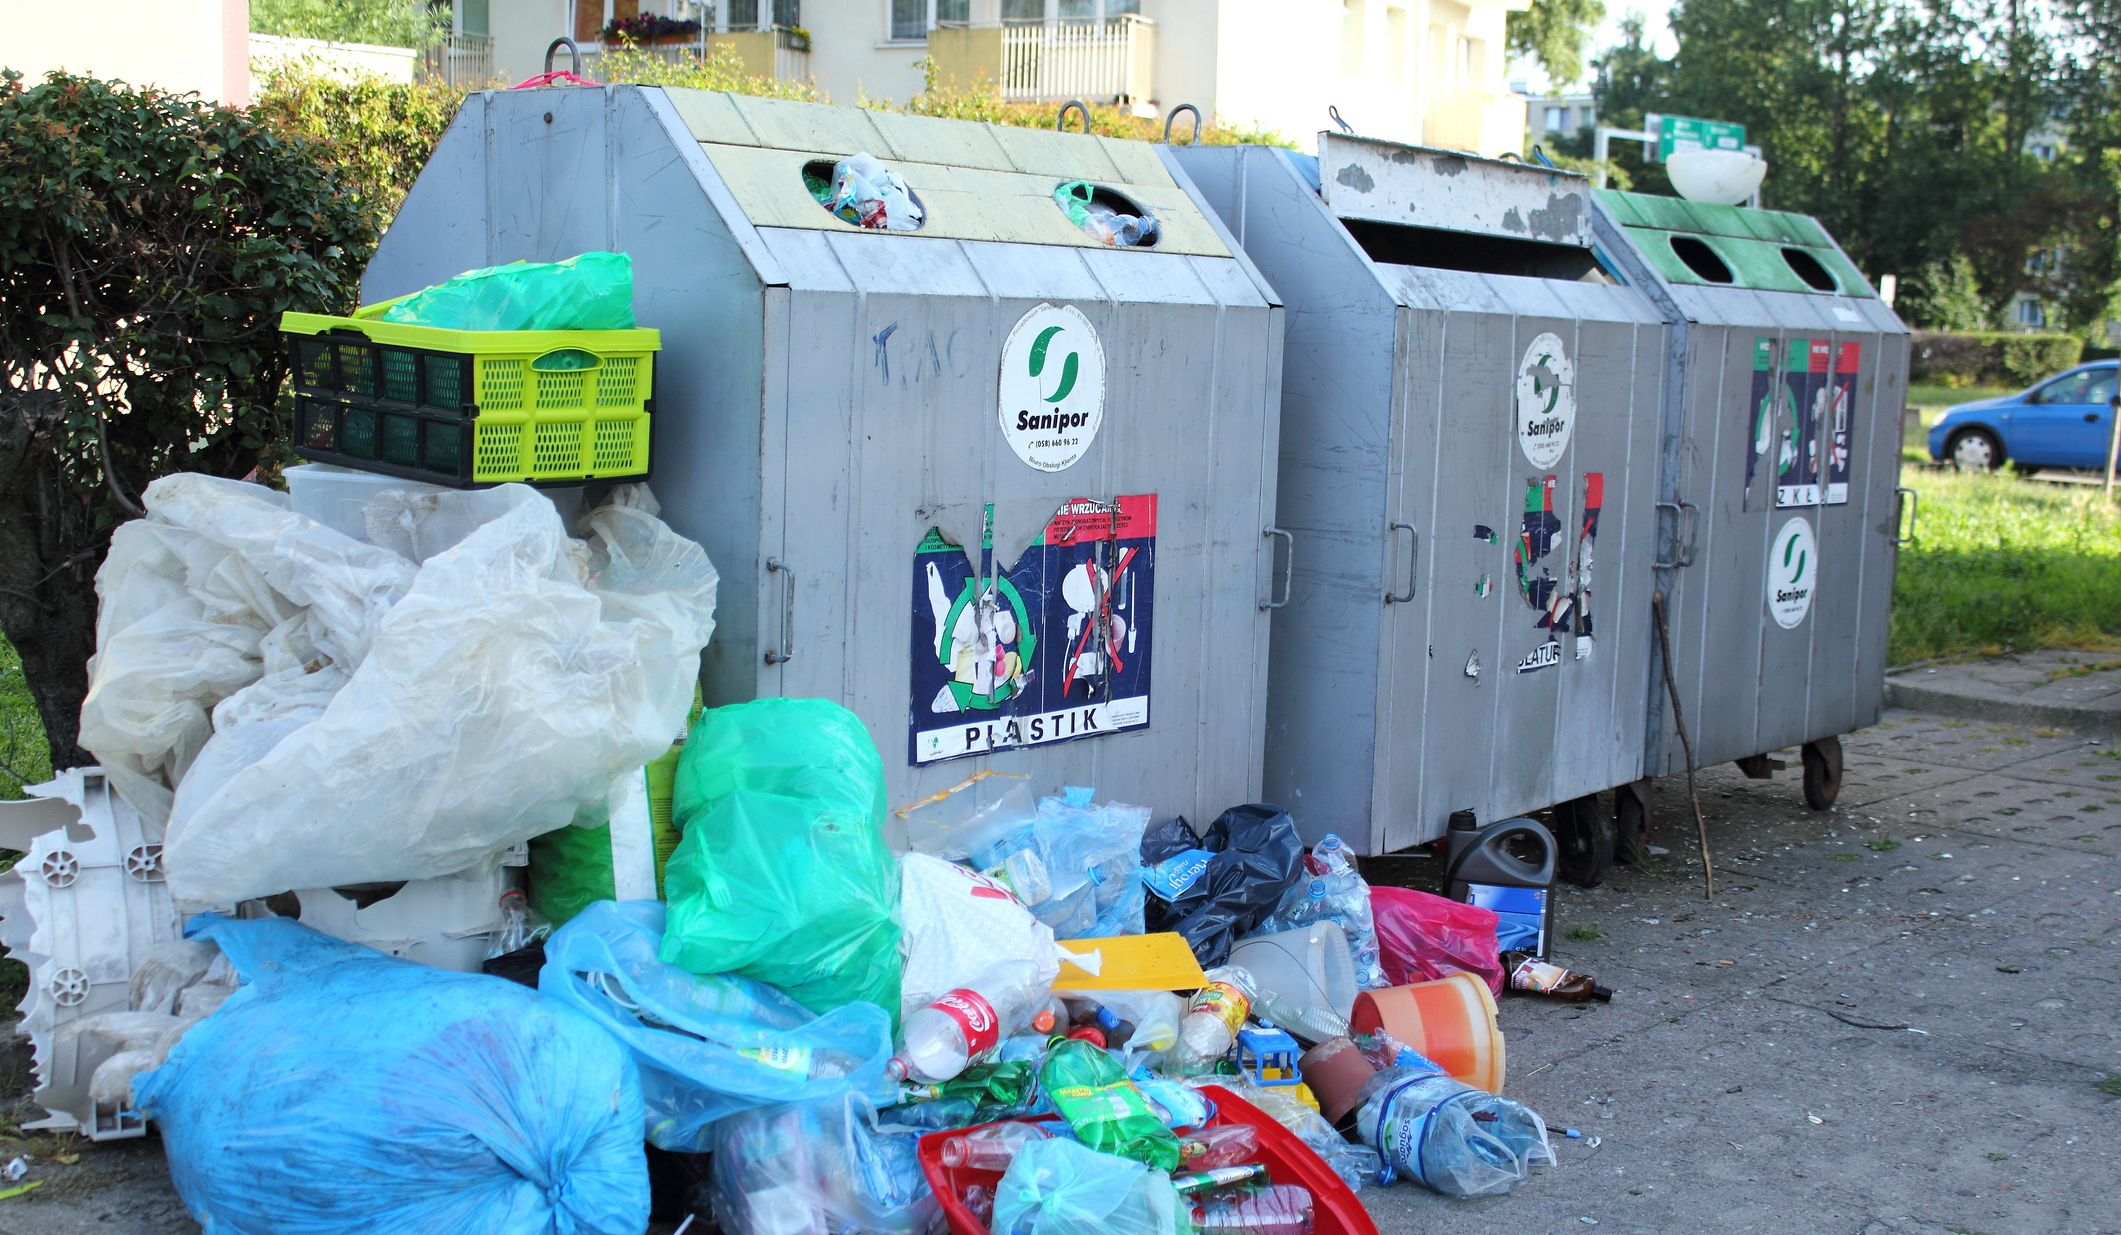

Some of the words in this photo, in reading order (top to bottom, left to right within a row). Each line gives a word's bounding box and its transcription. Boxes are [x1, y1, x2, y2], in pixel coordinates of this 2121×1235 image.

[1016, 407, 1089, 434] Sanipor
[1527, 417, 1565, 438] Sanipor
[1035, 440, 1051, 448] (058)
[1052, 439, 1062, 447] 660
[1064, 438, 1070, 446] 96
[1028, 456, 1042, 467] Biuro
[1061, 454, 1077, 467] Klienta
[1776, 587, 1807, 604] Sanipor
[1519, 645, 1561, 667] LATUR
[965, 708, 1098, 750] PLASTIK
[1399, 1119, 1411, 1165] saguaro
